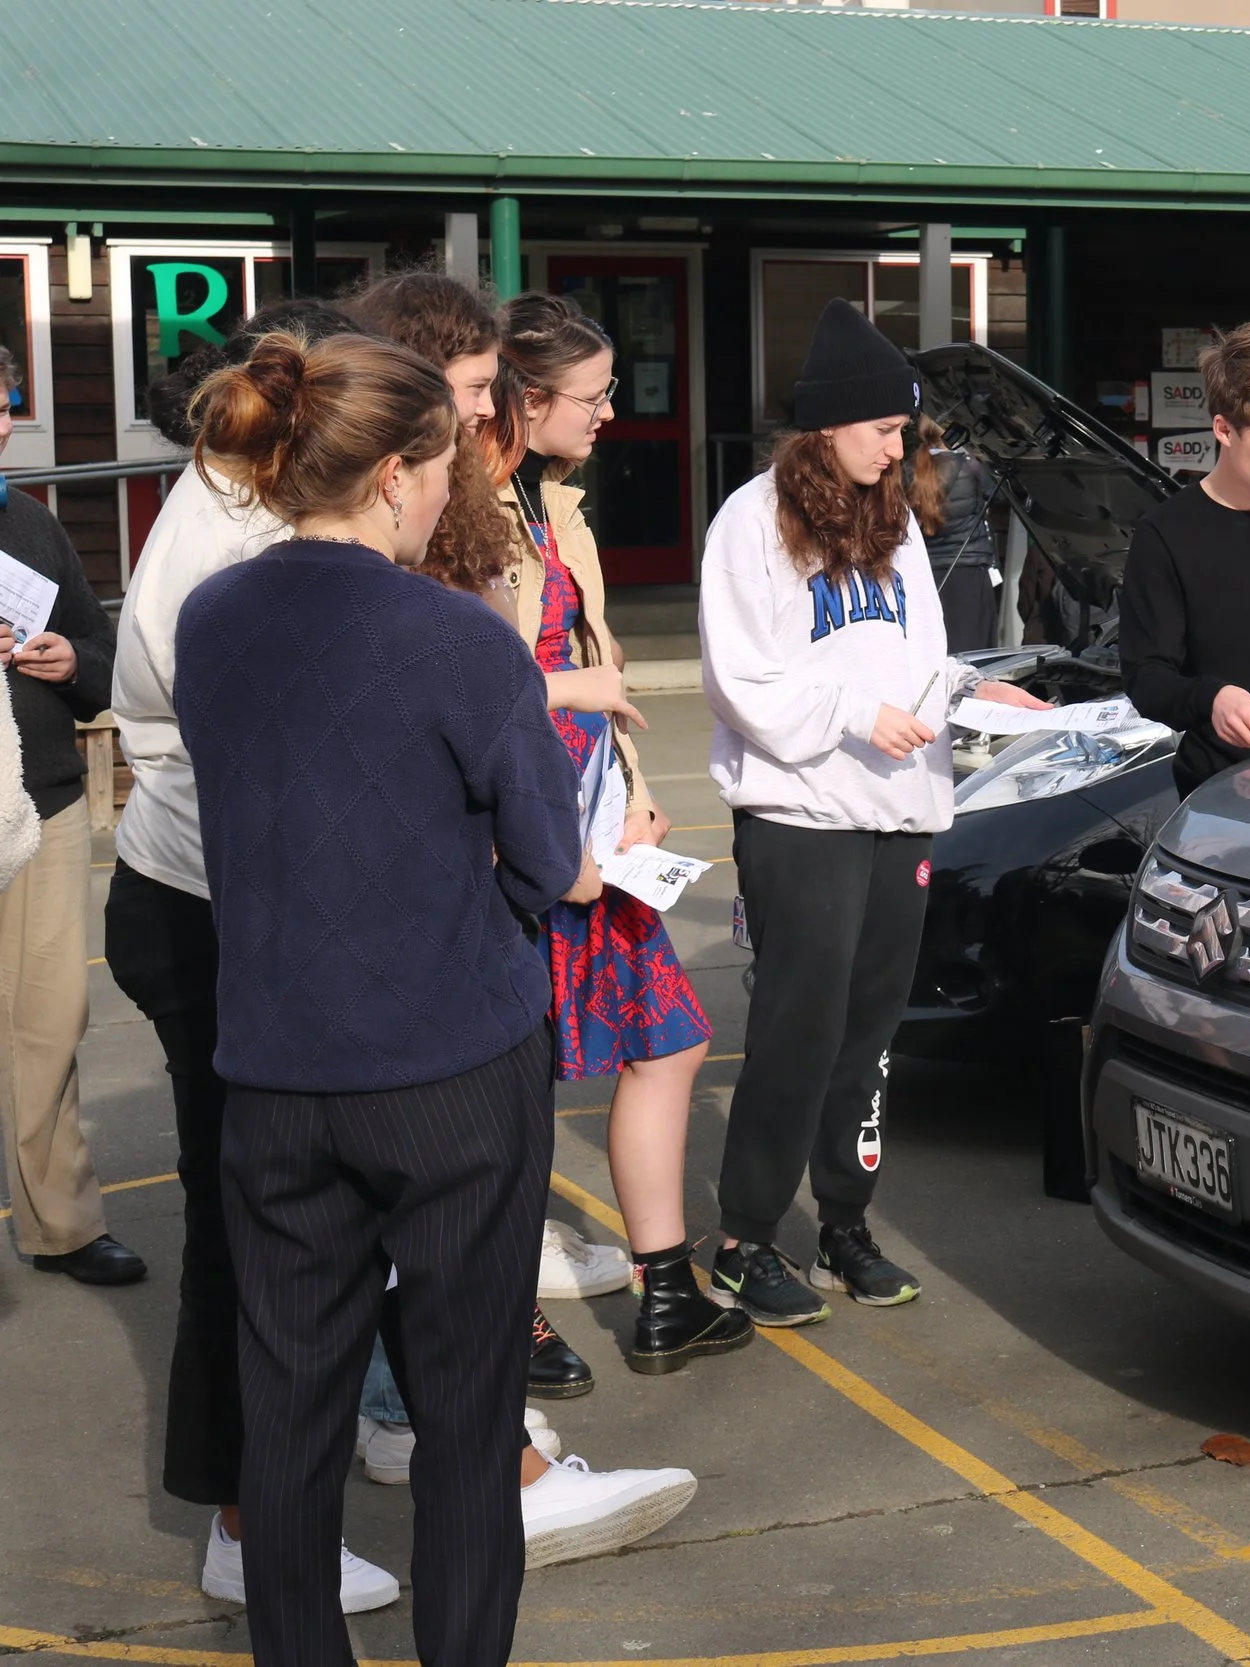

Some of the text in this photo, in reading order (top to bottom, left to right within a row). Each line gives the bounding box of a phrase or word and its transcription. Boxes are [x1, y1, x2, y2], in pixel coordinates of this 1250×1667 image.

[146, 262, 229, 357] R
[1163, 386, 1203, 400] SADD
[1163, 441, 1202, 455] SADD
[1140, 1116, 1232, 1203] JTK336
